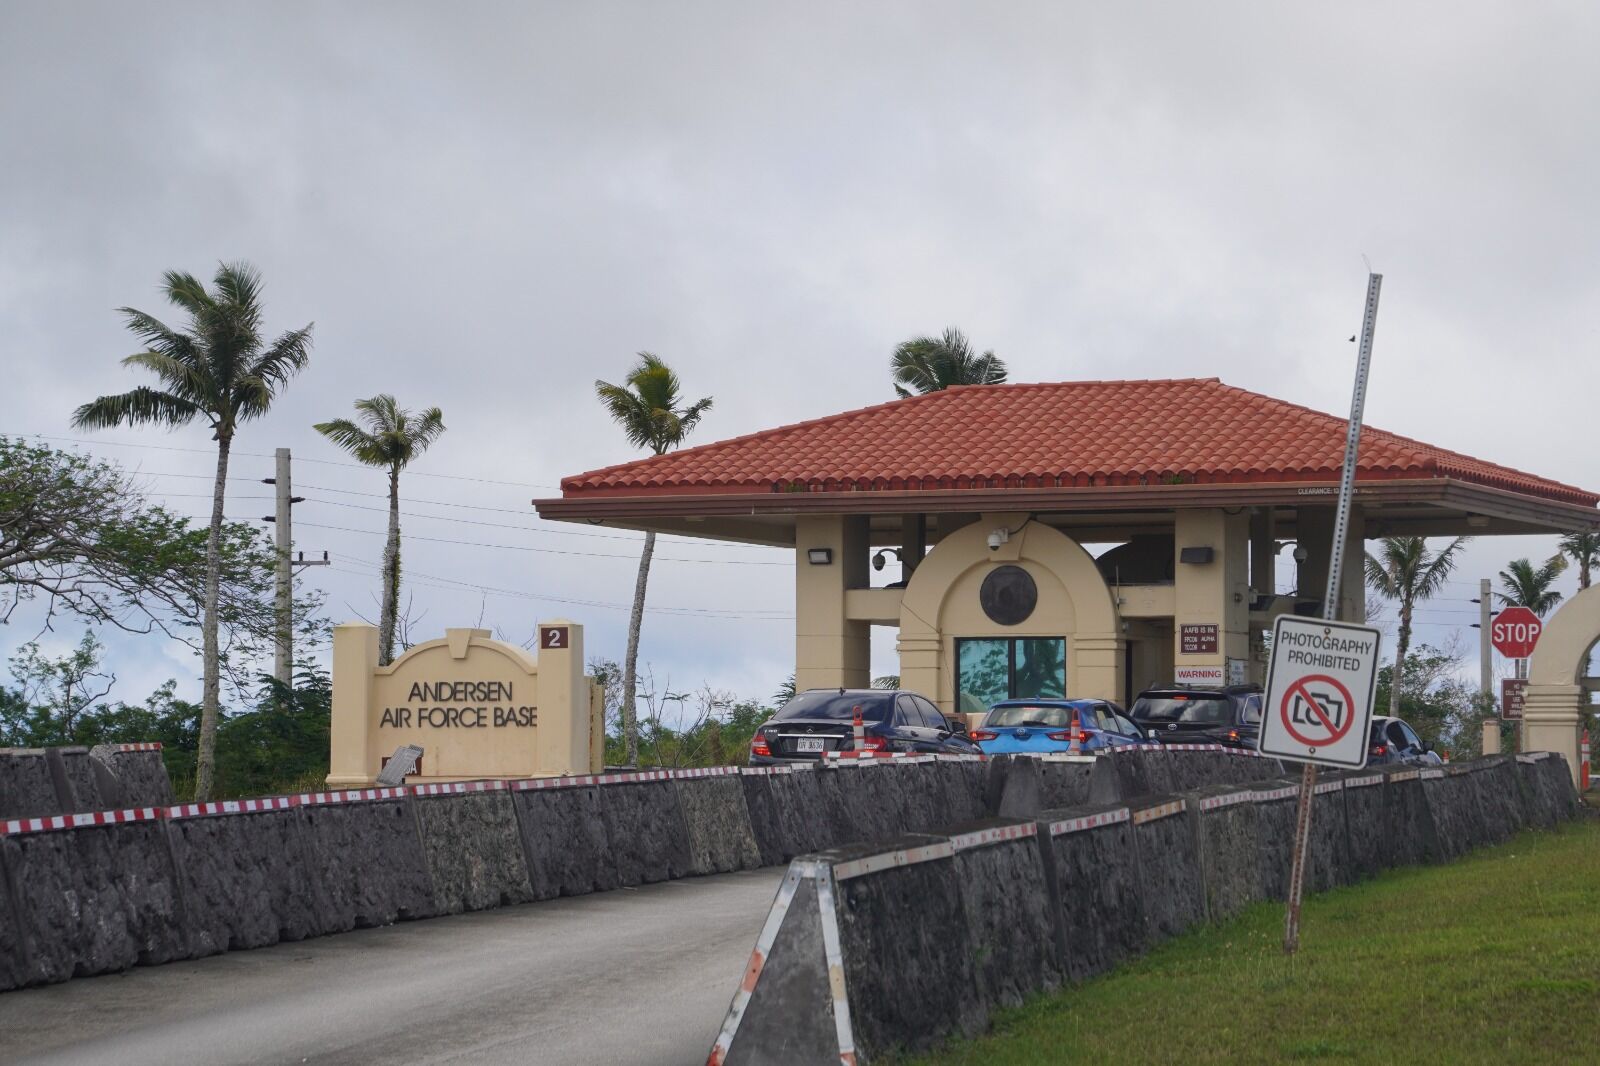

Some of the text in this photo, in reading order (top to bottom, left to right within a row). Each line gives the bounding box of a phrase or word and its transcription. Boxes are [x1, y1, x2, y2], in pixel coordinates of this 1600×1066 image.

[548, 629, 561, 647] 2
[1281, 631, 1373, 656] PHOTOGRAPHY
[1494, 624, 1539, 642] STOP
[1288, 649, 1361, 672] PROHIBITED
[1178, 670, 1222, 679] WARNING
[407, 681, 513, 702] ANDERSEN
[380, 706, 538, 728] AIR FORCE BASE
